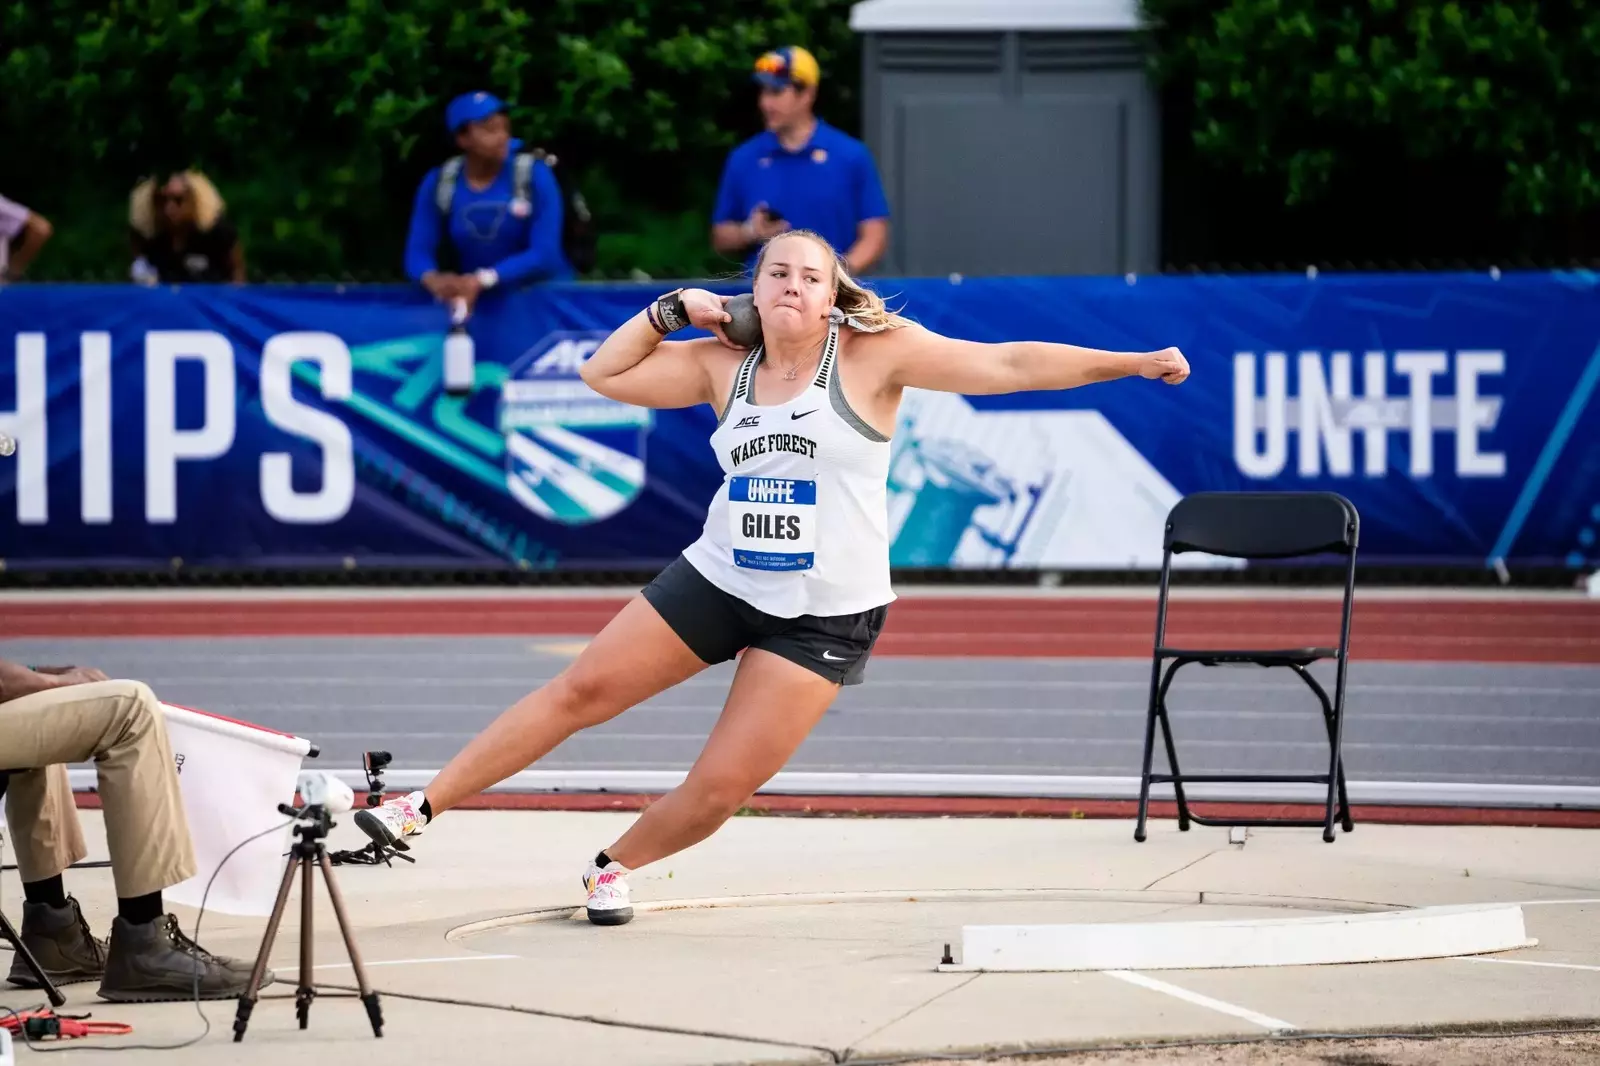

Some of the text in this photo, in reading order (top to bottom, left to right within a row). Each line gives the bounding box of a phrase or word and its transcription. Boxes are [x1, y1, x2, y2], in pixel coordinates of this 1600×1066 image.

[733, 415, 762, 430] ACC
[1233, 350, 1506, 478] UNITE
[730, 433, 817, 467] WAKE FOREST
[748, 478, 796, 503] UNITE
[742, 512, 801, 541] GILES
